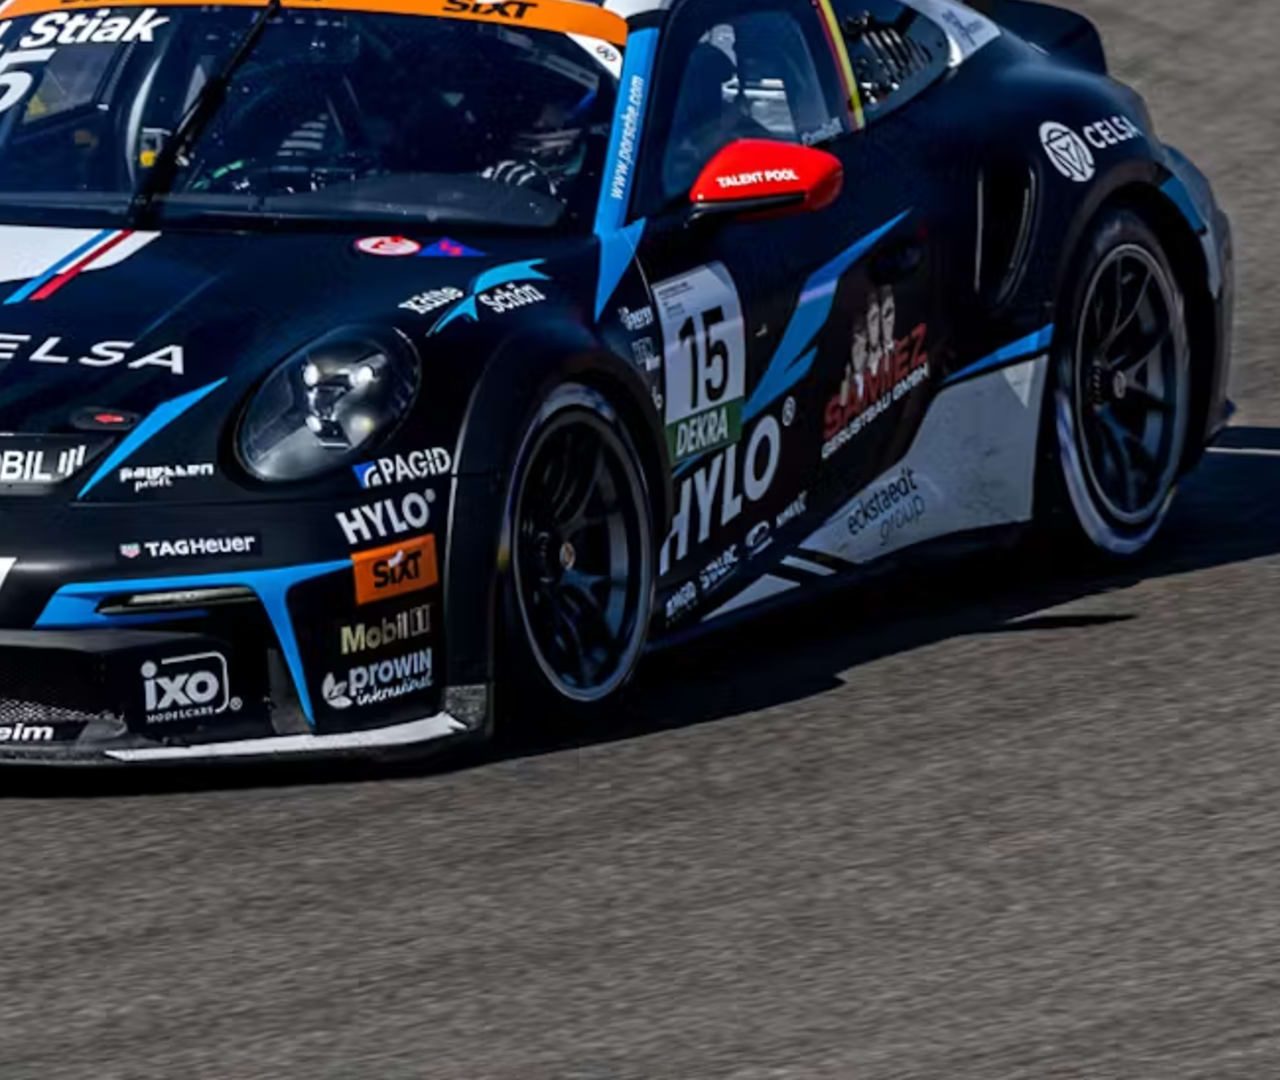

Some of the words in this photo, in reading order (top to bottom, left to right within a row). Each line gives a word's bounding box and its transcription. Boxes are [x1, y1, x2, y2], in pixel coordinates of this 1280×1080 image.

[20, 8, 170, 49] Stiak
[716, 171, 764, 188] TALENT
[764, 168, 799, 183] POOL
[677, 305, 730, 410] 15
[675, 409, 728, 457] DEKRA
[379, 446, 452, 484] PAGID
[336, 493, 431, 545] HYLO
[659, 414, 781, 577] HYLO
[847, 469, 919, 536] eckstaedt
[340, 610, 409, 655] Mobil
